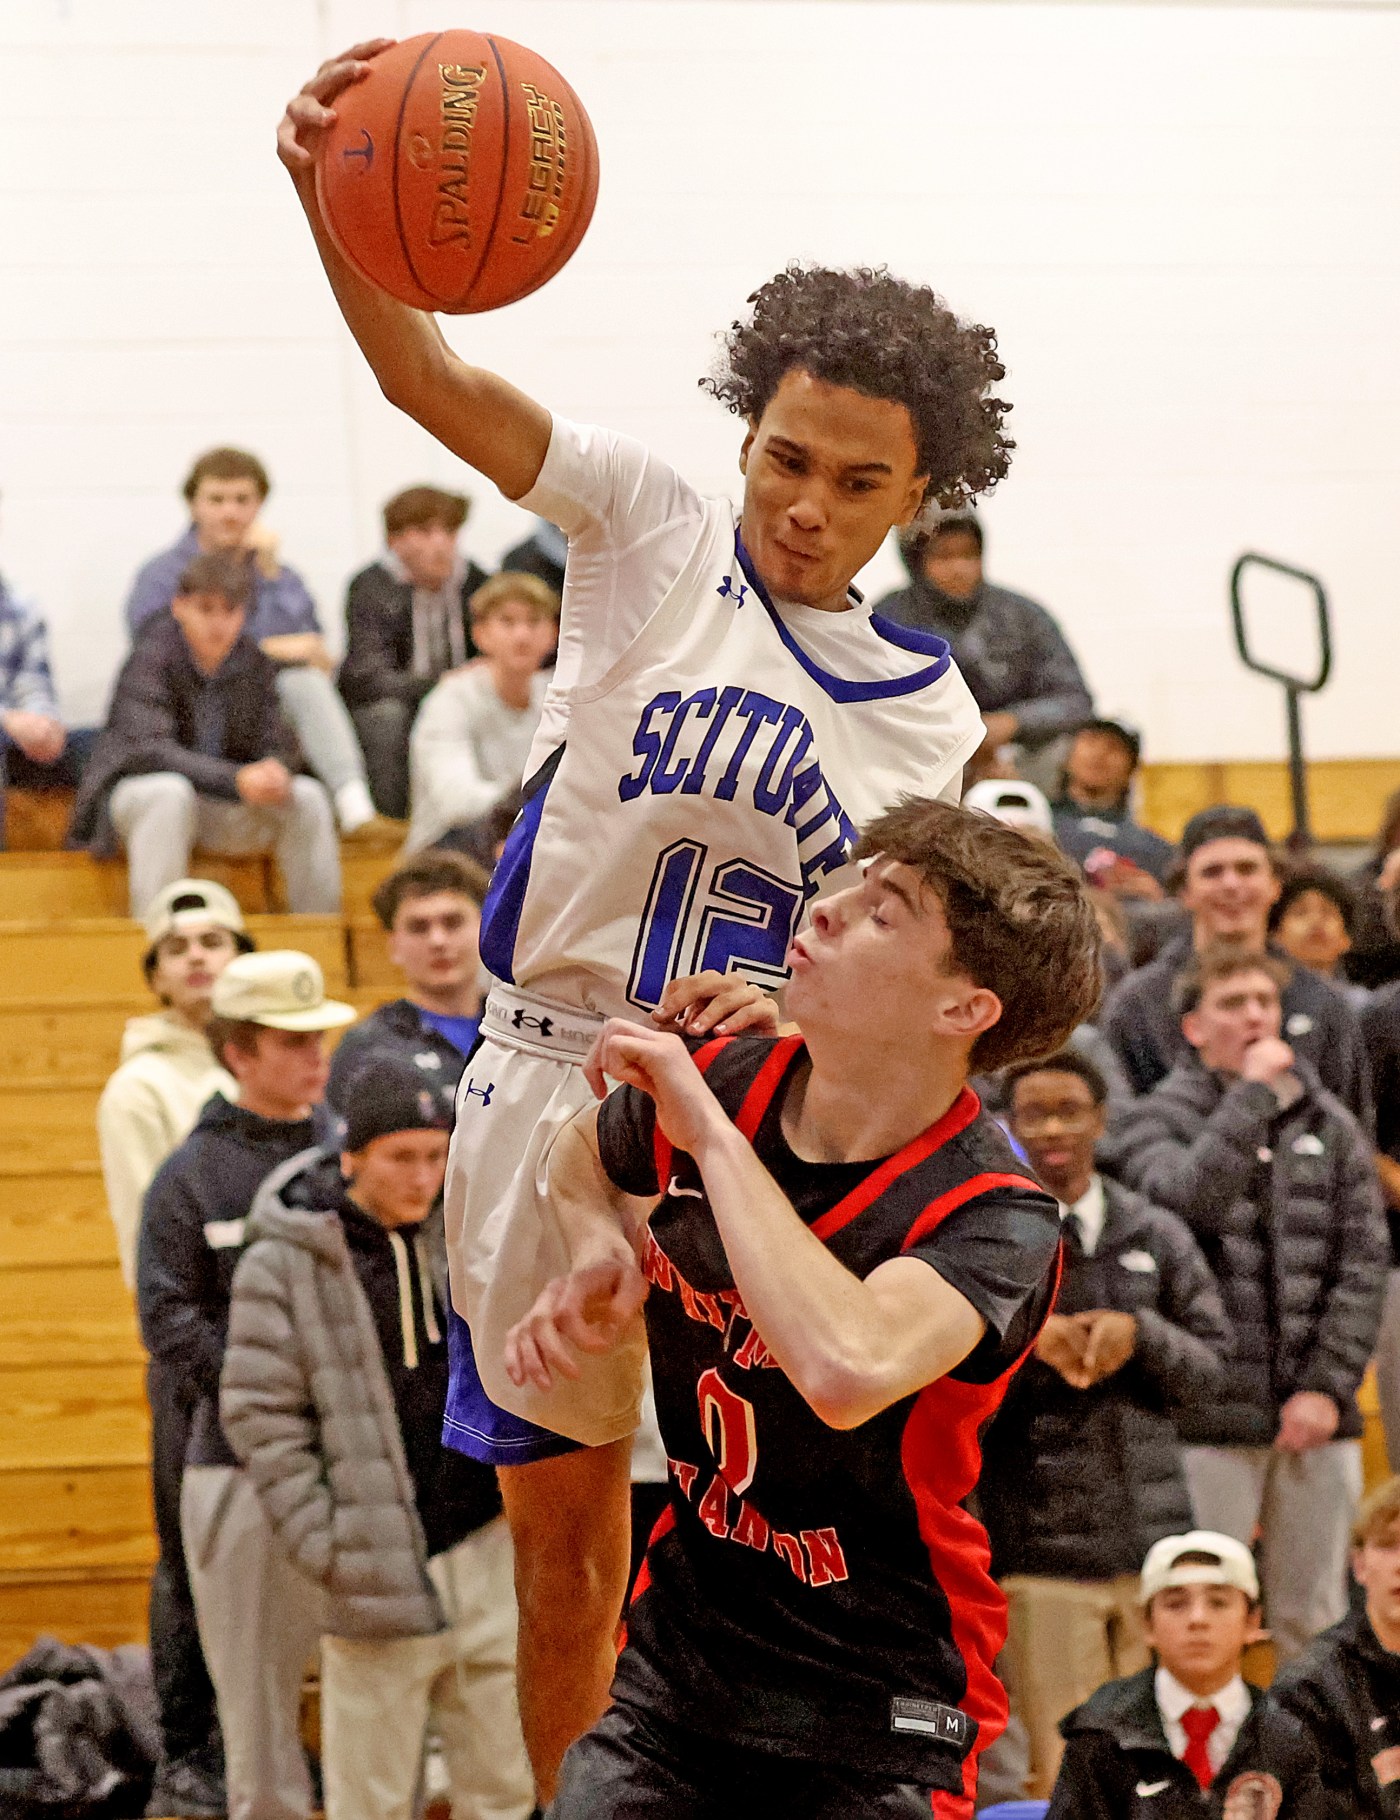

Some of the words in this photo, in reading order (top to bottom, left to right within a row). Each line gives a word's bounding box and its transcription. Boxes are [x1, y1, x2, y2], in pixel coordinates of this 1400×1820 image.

[428, 62, 488, 250] SPALDING
[512, 83, 554, 244] LEGACY
[626, 837, 805, 1013] 12
[698, 1367, 758, 1496] 0
[946, 1716, 959, 1733] M
